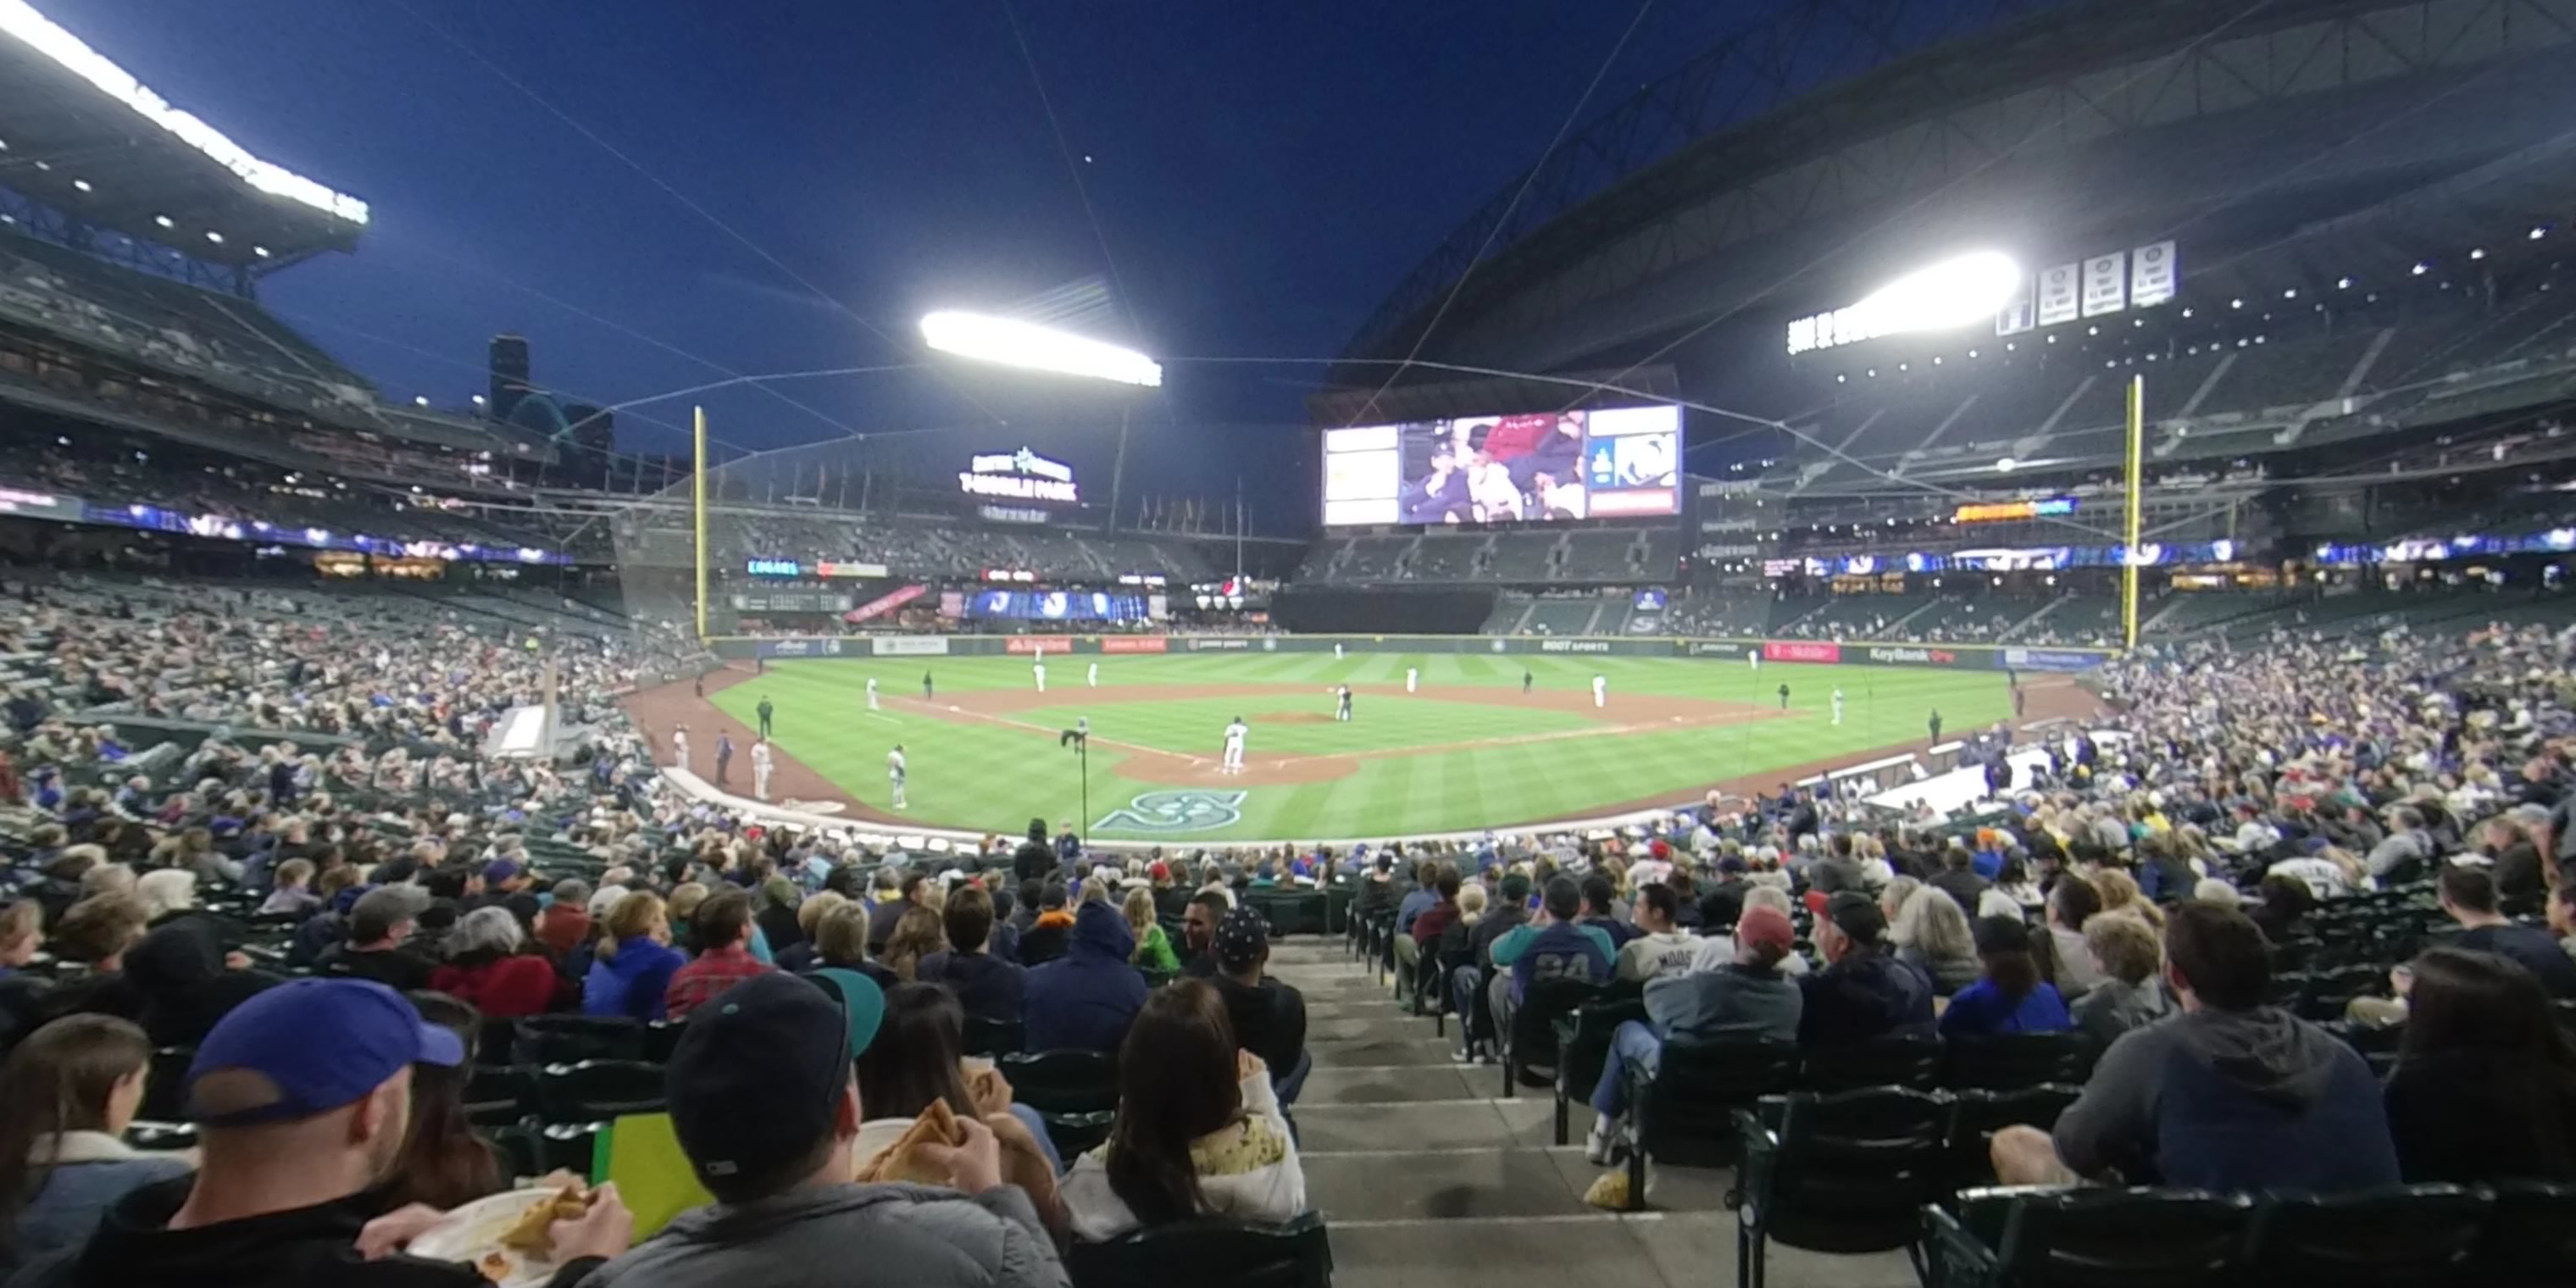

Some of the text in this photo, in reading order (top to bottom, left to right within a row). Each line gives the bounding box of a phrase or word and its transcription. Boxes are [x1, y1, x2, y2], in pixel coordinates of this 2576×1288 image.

[1541, 641, 1609, 652] ROOT SPORTS
[1869, 647, 1929, 663] KeyBank
[1534, 952, 1591, 983] 24
[1657, 949, 1696, 969] MOOS
